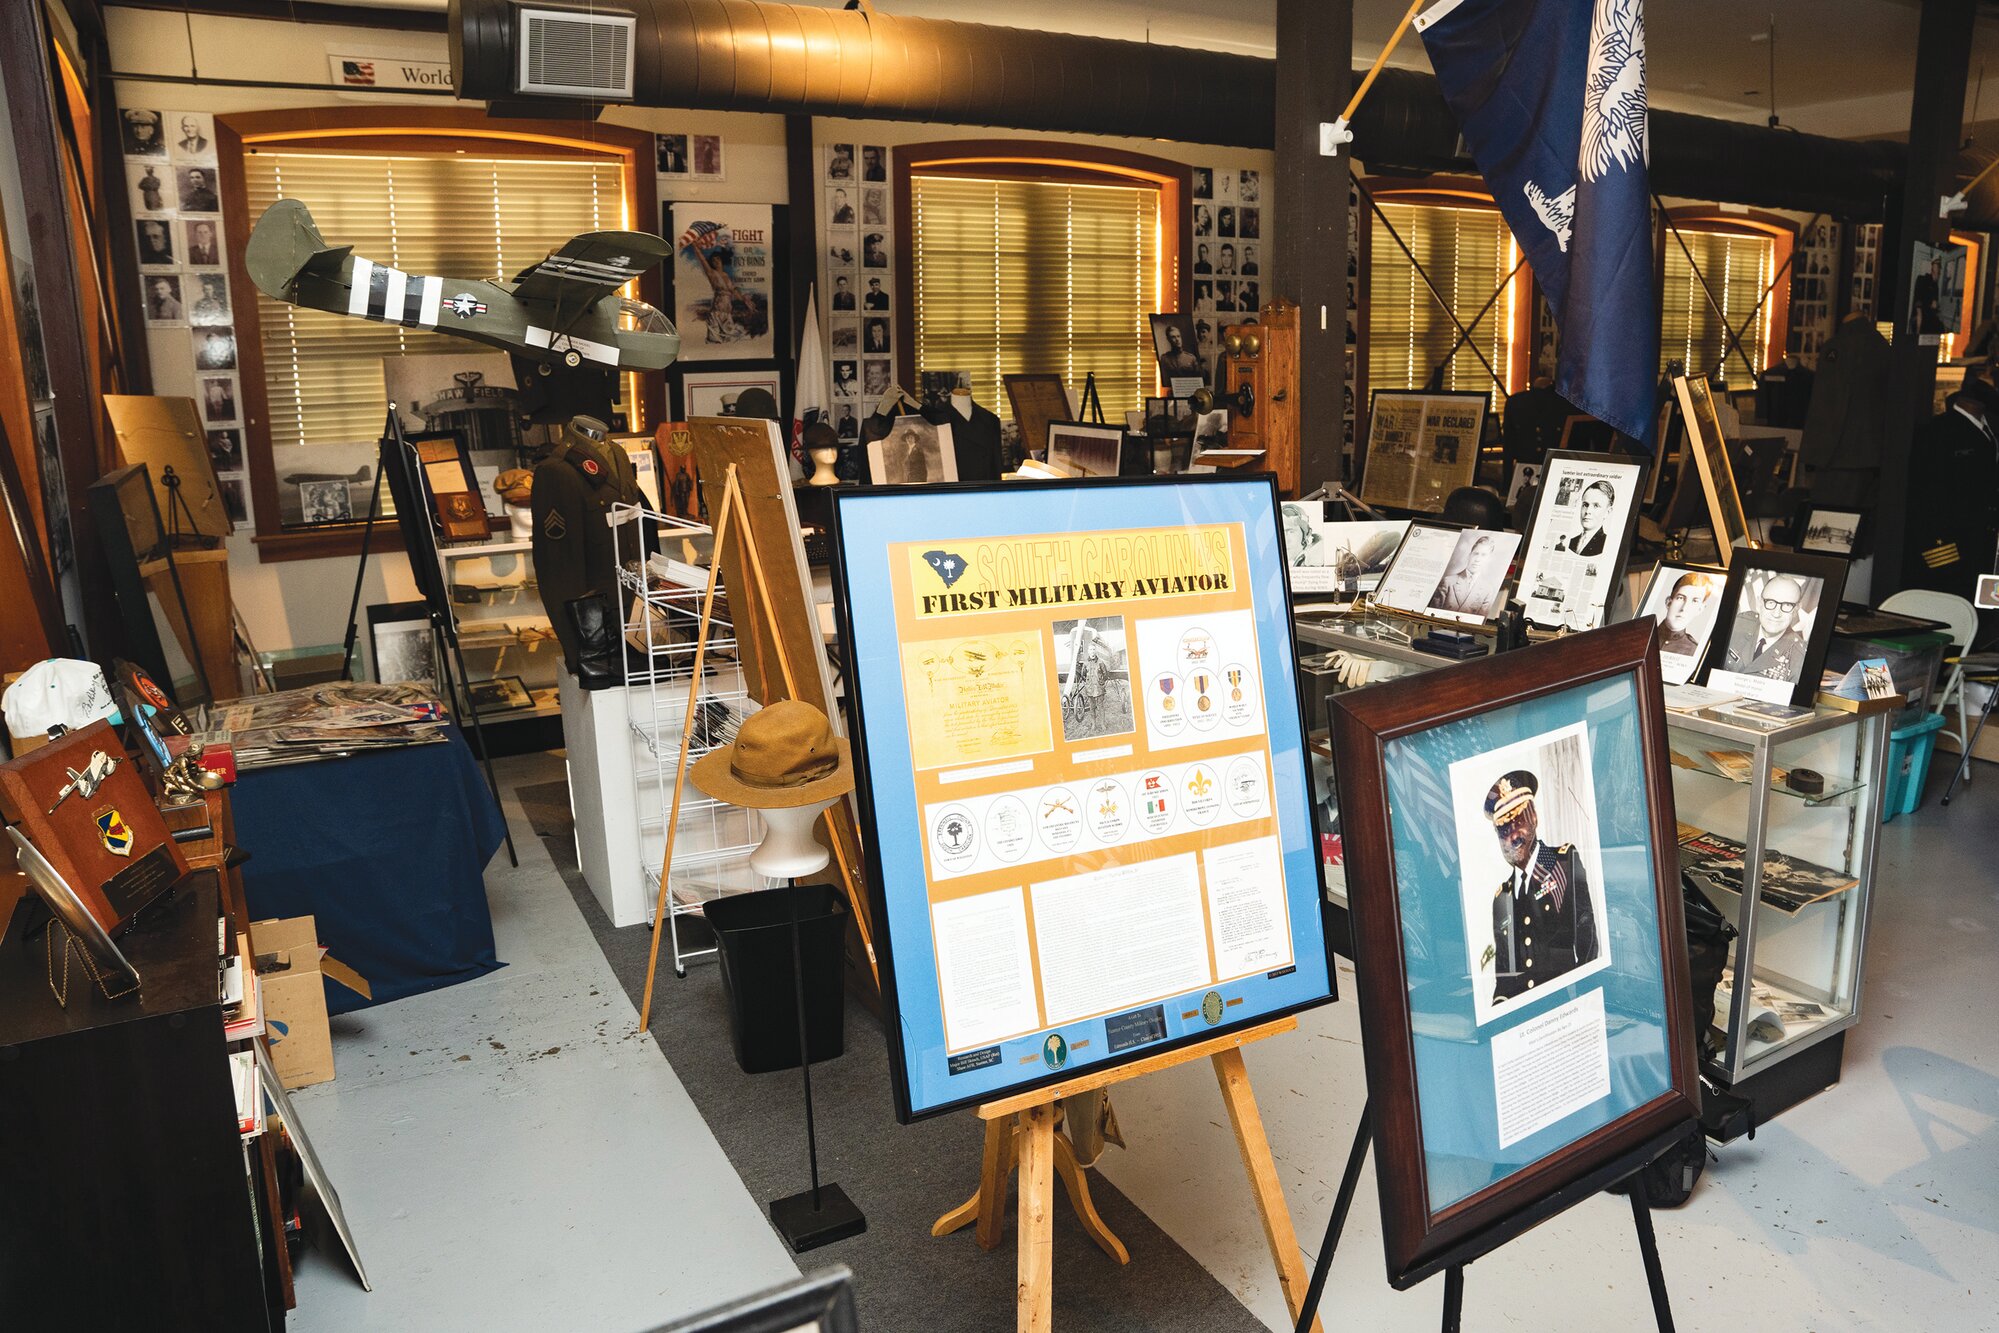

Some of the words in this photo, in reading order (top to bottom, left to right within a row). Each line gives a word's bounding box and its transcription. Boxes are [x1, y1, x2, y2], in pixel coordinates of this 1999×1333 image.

[402, 67, 453, 85] World
[732, 229, 764, 241] FIGHT
[434, 388, 465, 401] SHAW
[474, 387, 504, 398] FIELD
[1442, 416, 1476, 429] DECLARED
[1583, 471, 1609, 480] extraordinary
[976, 541, 1075, 605] SOUTH
[1080, 531, 1229, 594] CAROLINA'S
[922, 591, 999, 614] FIRST
[1007, 580, 1125, 607] MILITARY
[1132, 573, 1229, 597] AVIATOR
[982, 696, 1010, 706] AVIATOR
[1698, 836, 1730, 848] Day
[1689, 840, 1739, 859] Infamy
